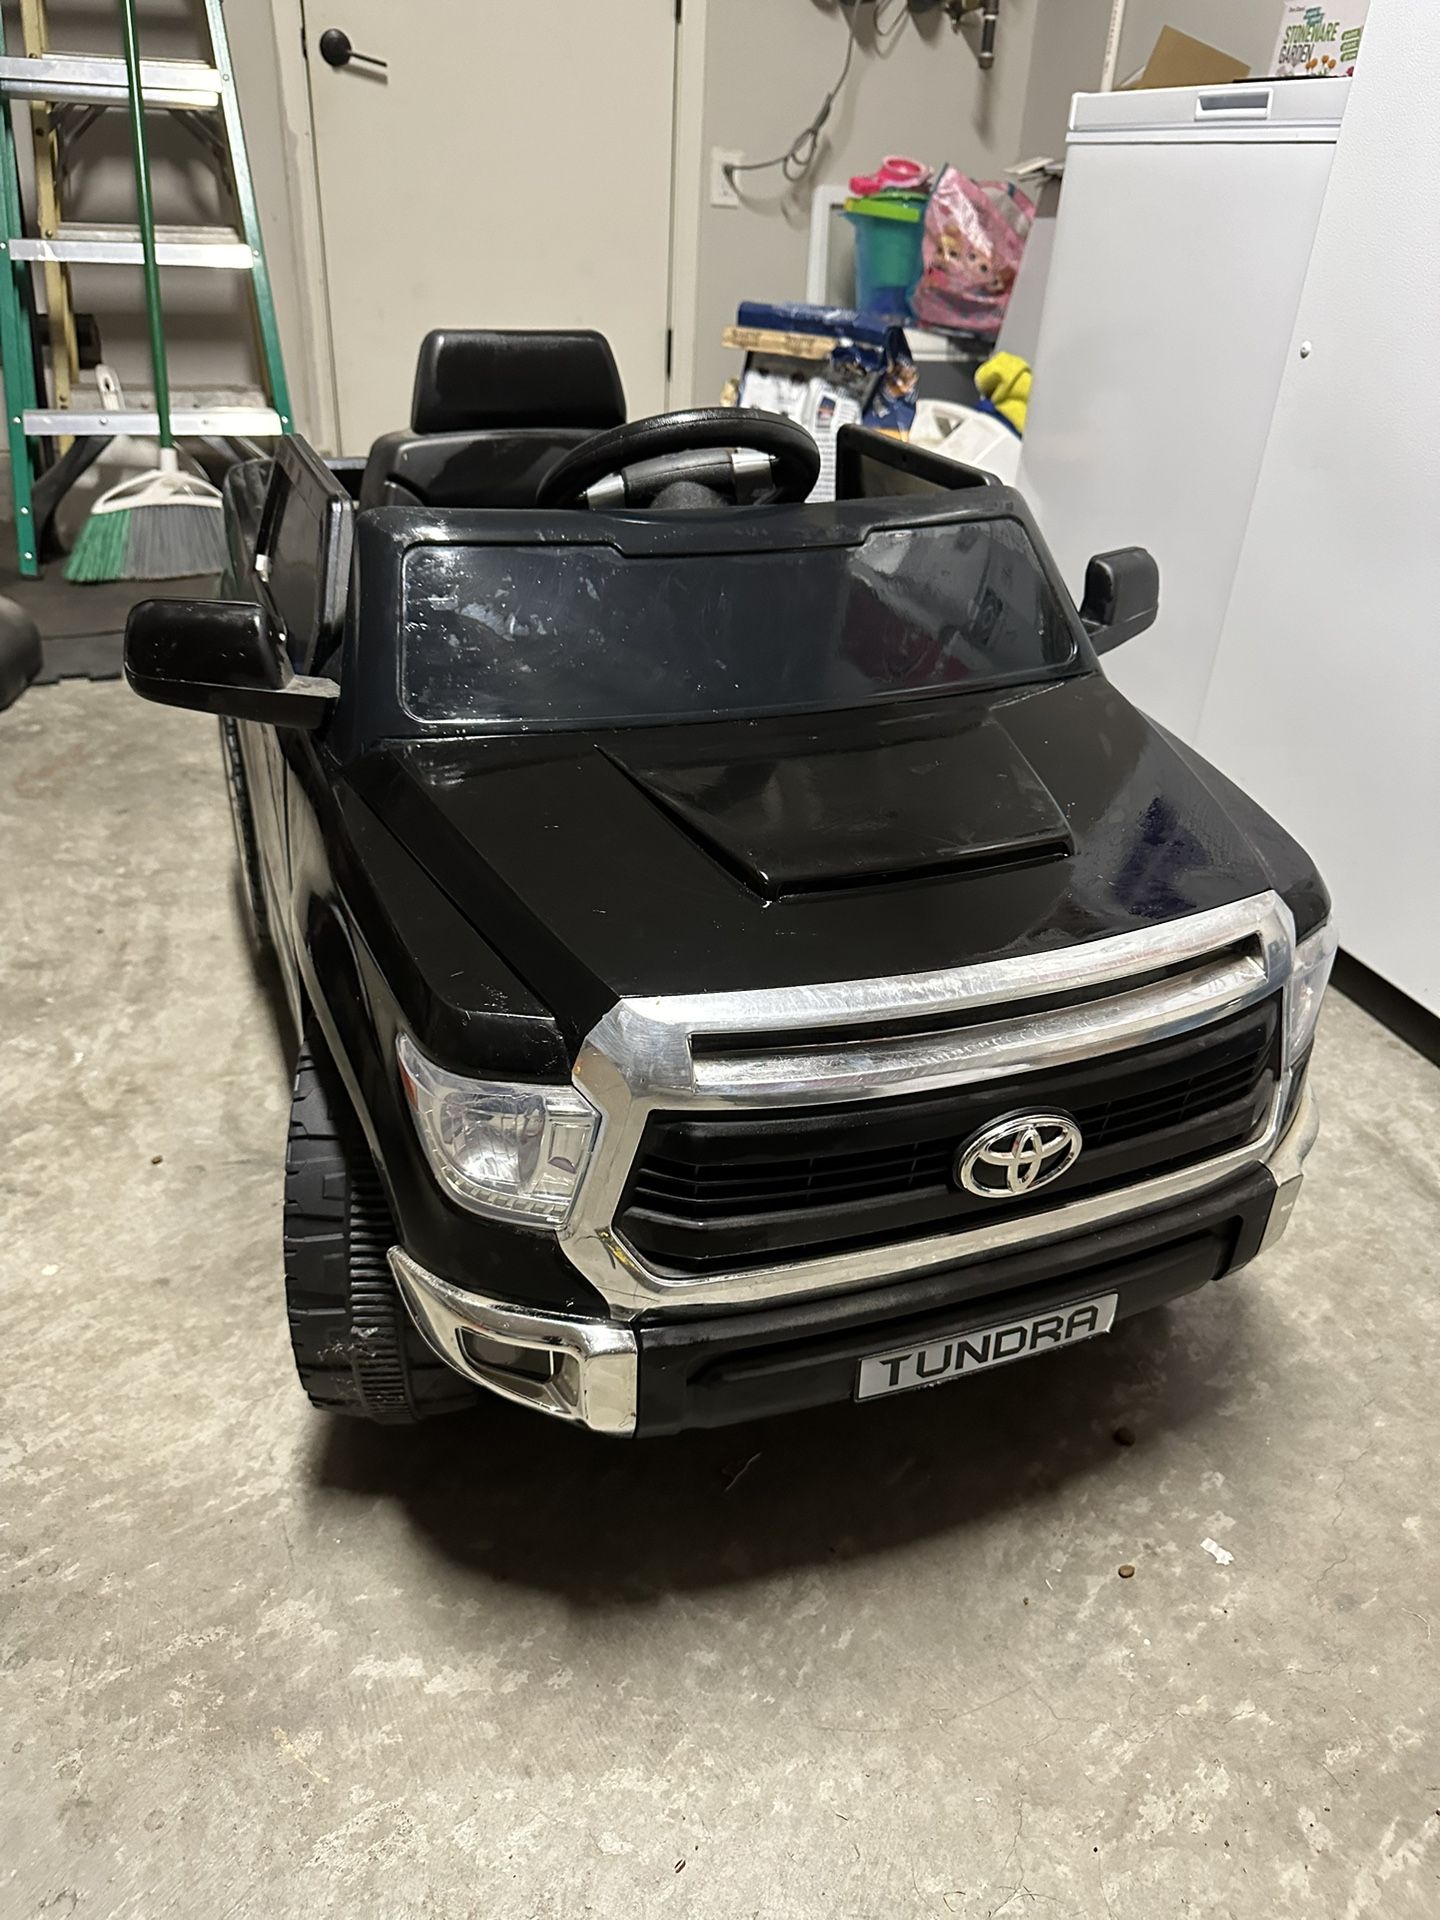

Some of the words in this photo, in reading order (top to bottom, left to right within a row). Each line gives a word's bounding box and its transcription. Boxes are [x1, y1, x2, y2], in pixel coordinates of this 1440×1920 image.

[1283, 22, 1340, 44] STONEWARE
[1279, 43, 1314, 65] GARDEN
[879, 1304, 1099, 1387] TUNDRA
